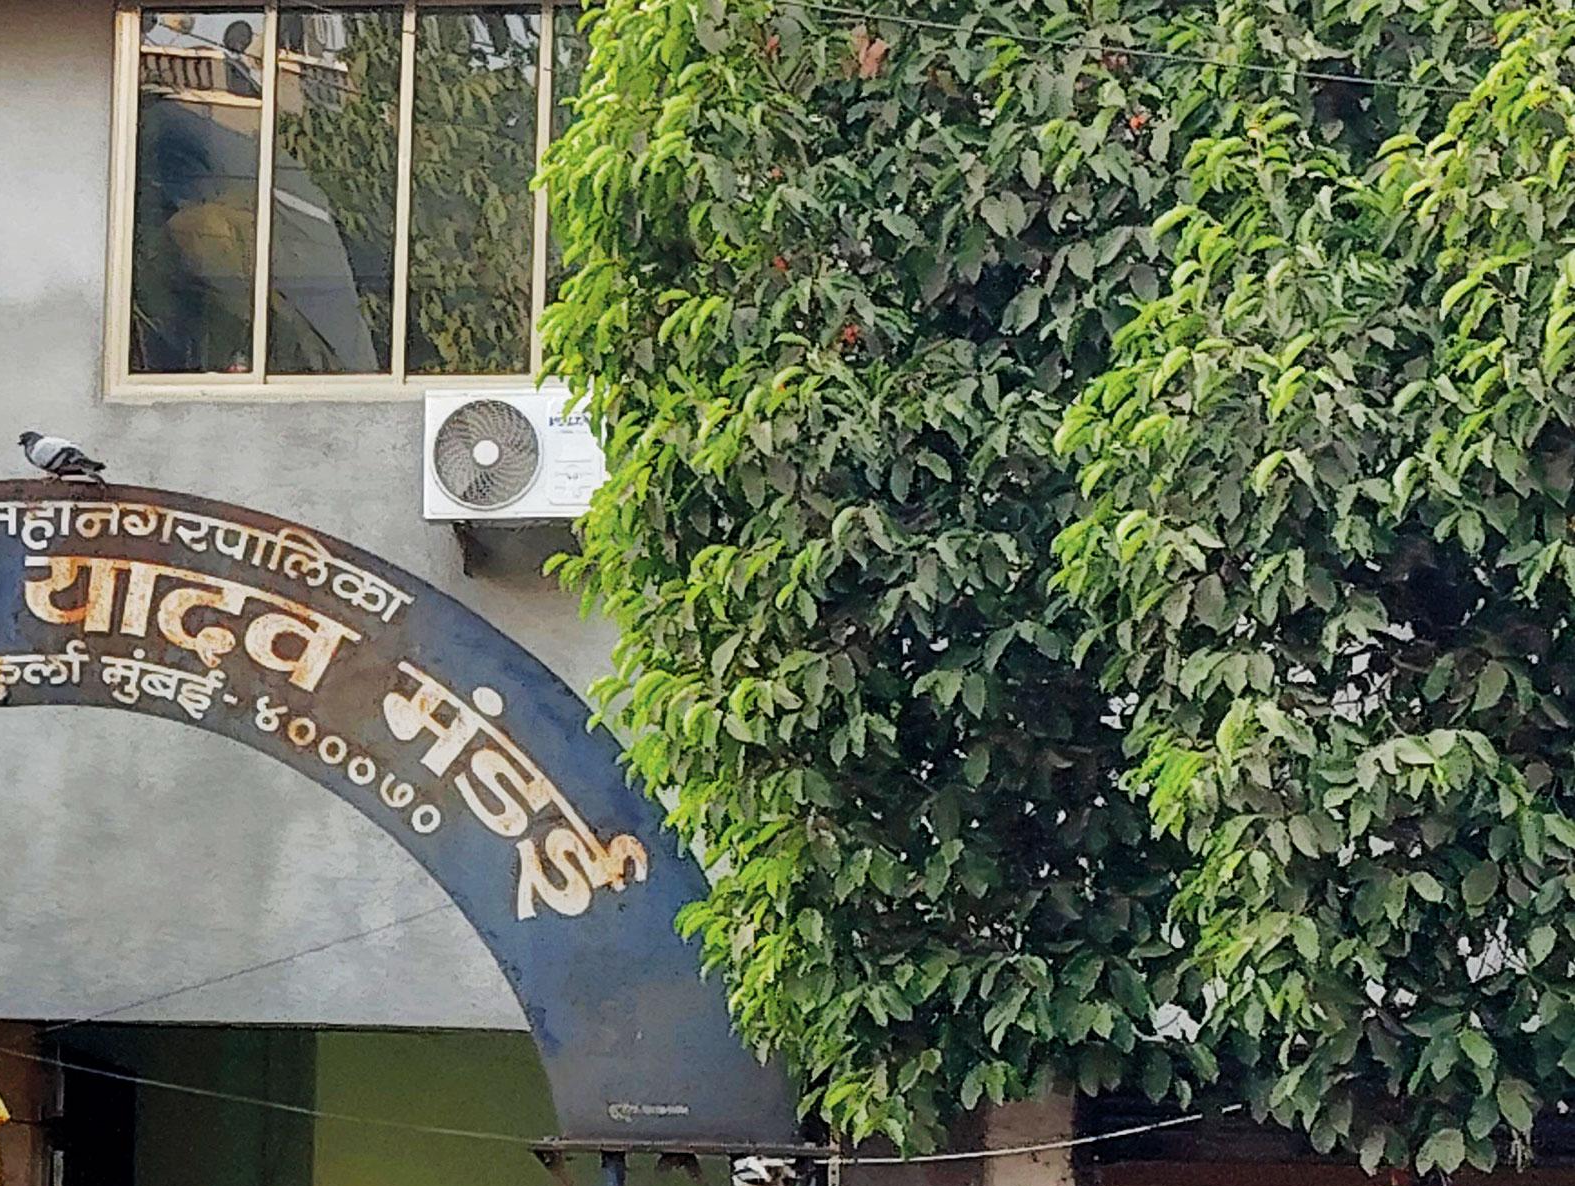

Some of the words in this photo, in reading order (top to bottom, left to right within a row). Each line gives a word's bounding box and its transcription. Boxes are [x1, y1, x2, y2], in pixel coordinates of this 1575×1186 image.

[25, 555, 362, 693] यादव
[383, 660, 648, 921] मंडई
[255, 696, 442, 834] ४०००७०
